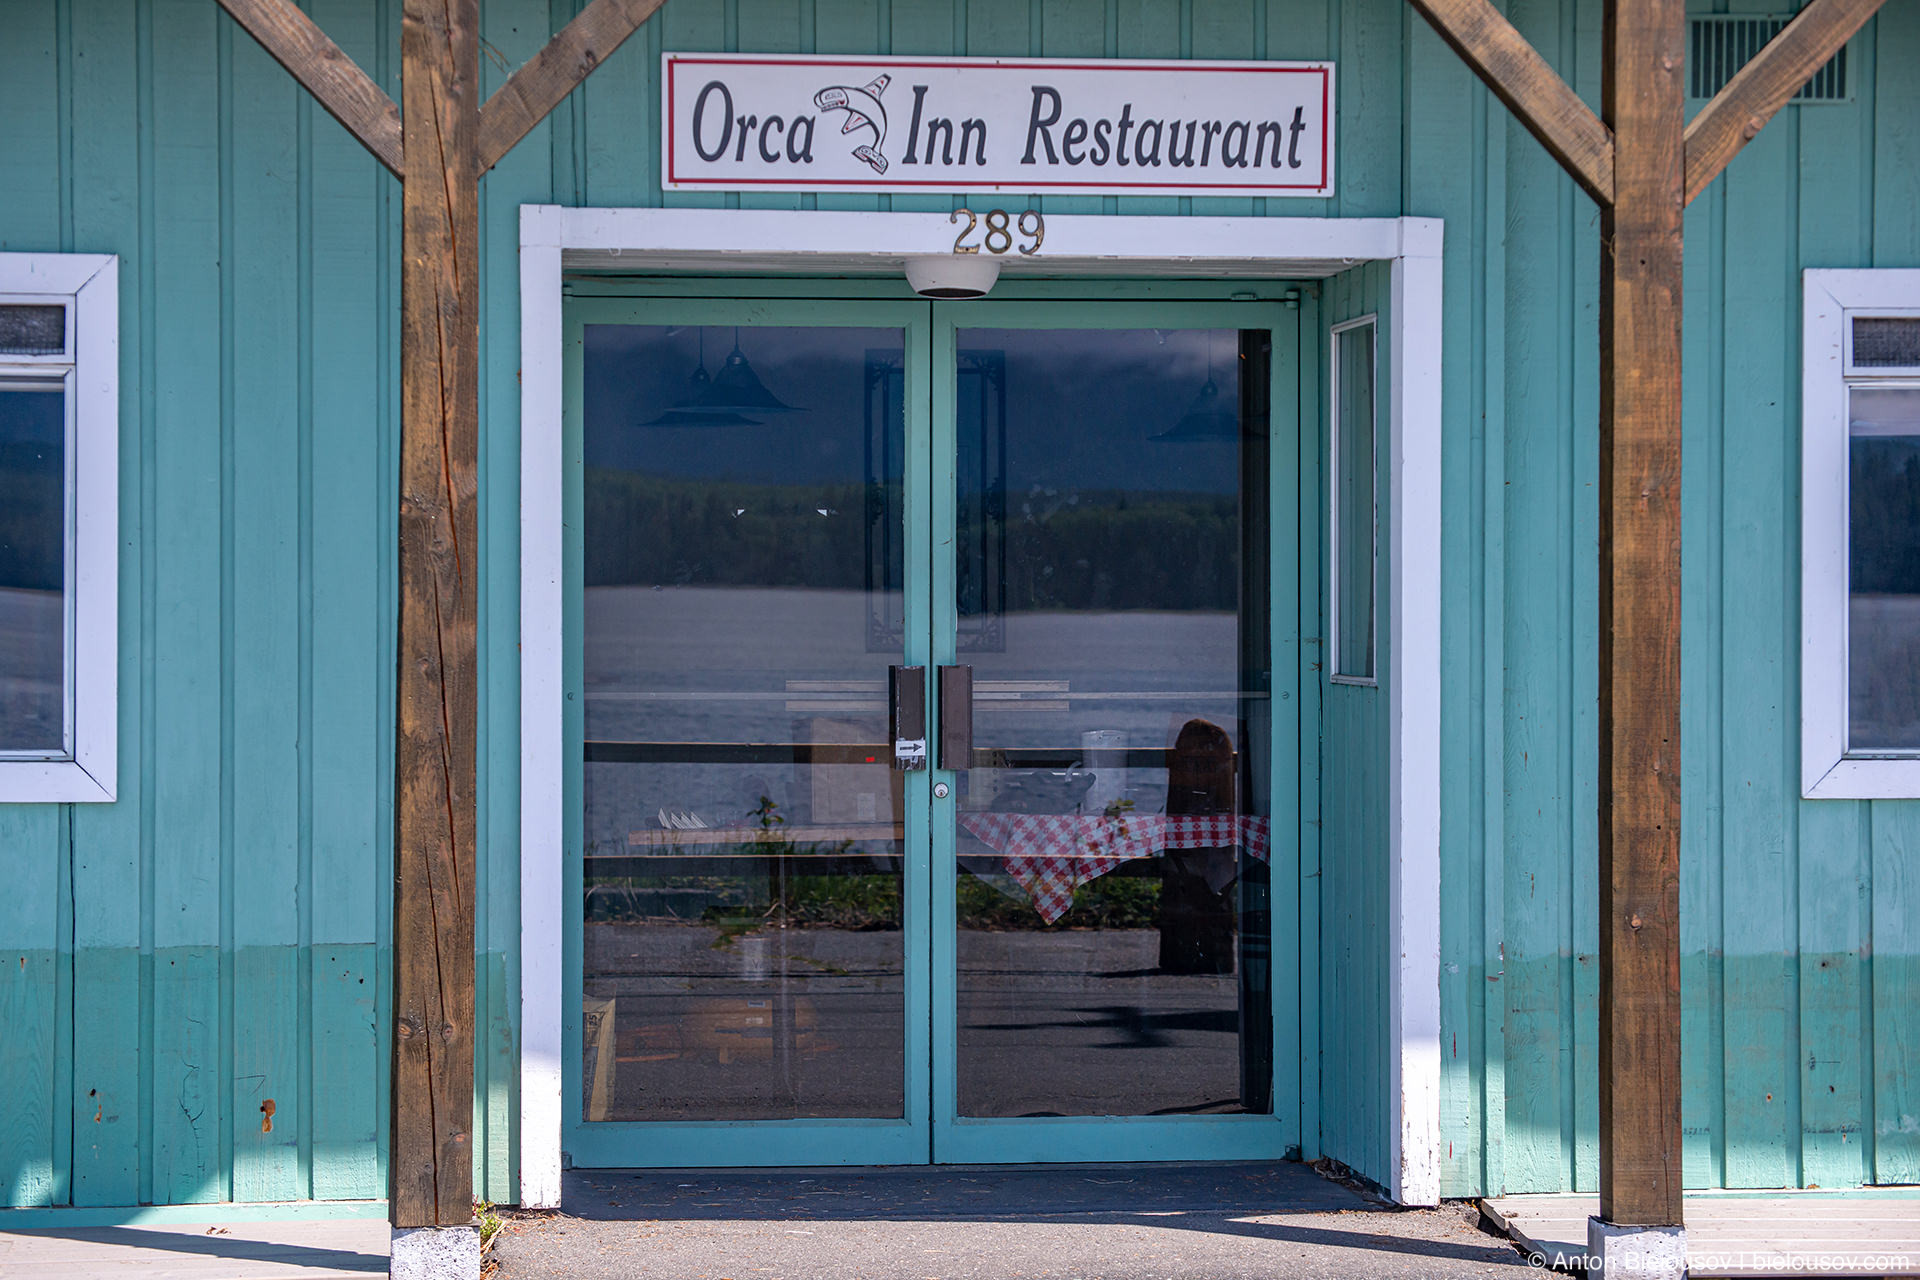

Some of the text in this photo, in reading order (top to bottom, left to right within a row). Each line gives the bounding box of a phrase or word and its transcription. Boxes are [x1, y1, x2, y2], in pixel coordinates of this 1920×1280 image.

[692, 80, 1307, 170] Orca Inn Restaurant
[950, 208, 1045, 256] 289
